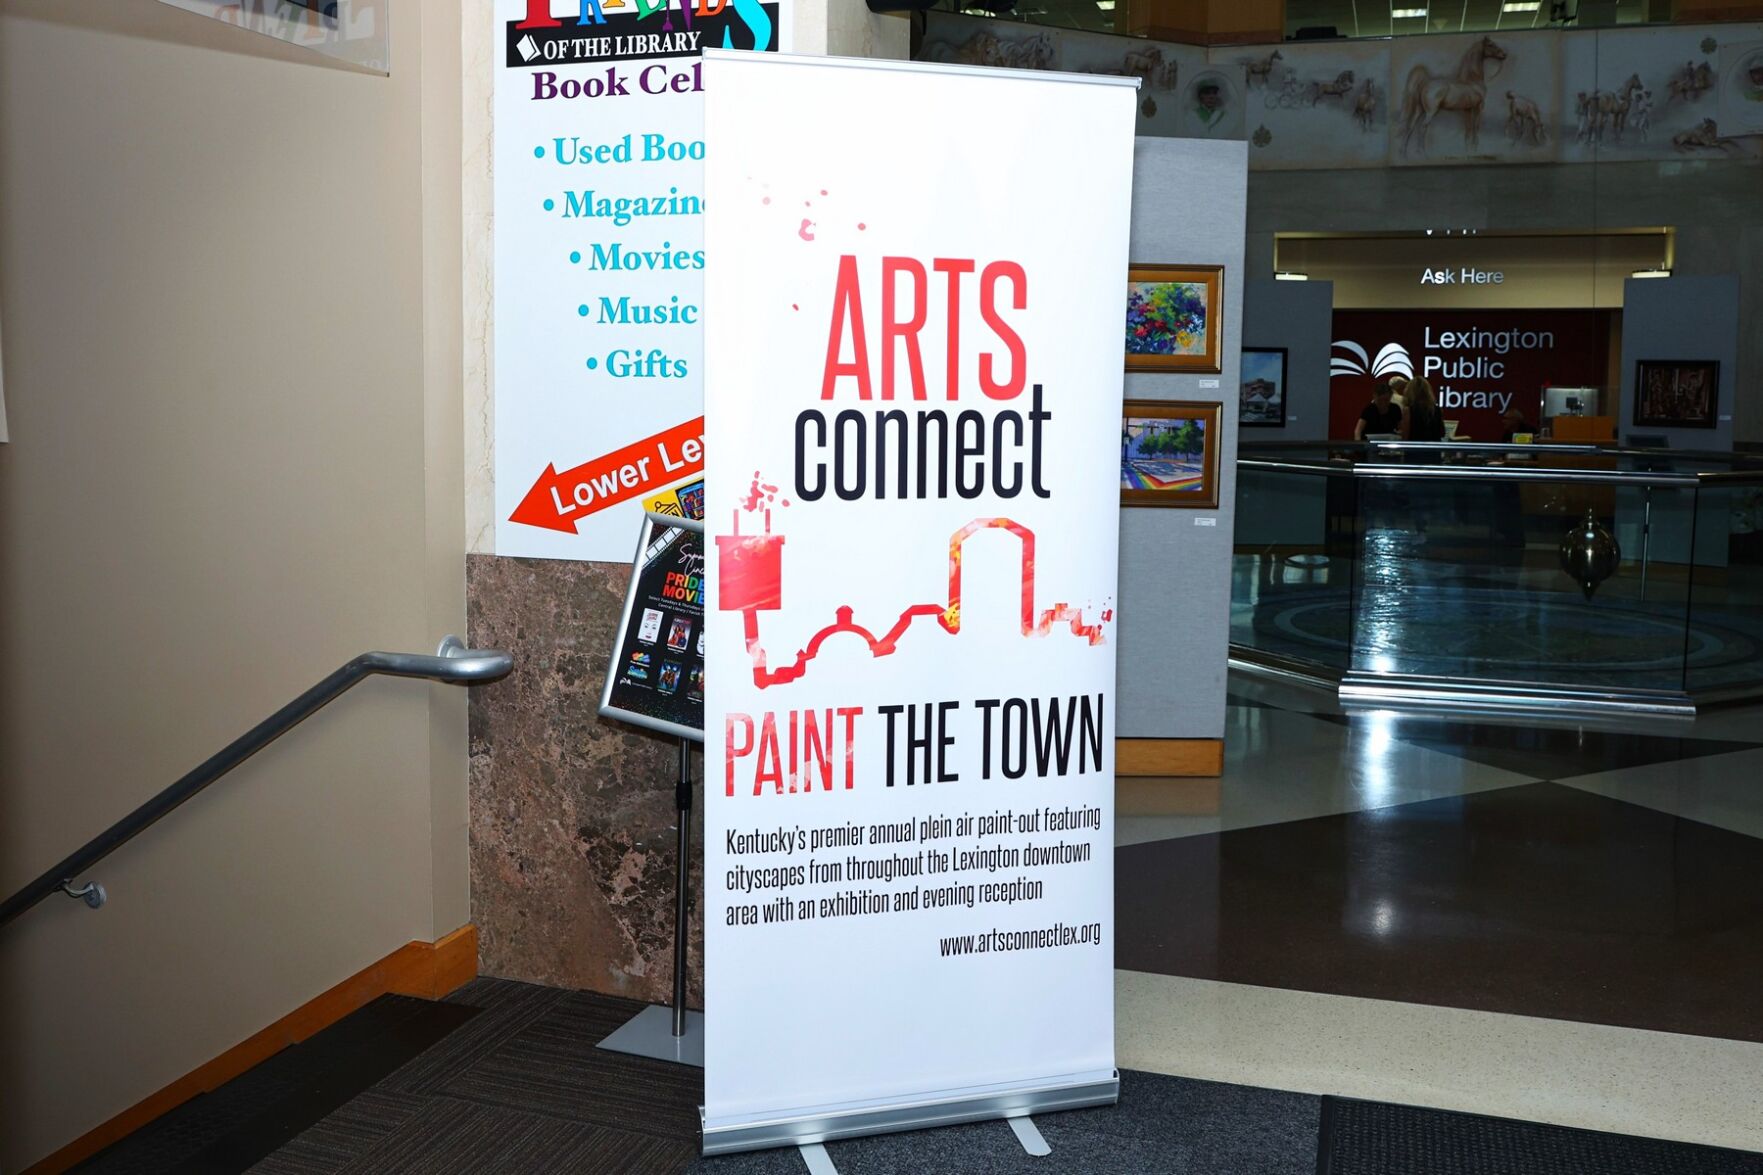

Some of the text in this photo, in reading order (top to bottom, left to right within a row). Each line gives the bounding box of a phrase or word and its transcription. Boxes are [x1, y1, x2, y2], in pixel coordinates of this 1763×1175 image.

[544, 31, 702, 60] OF THE LIBRARY
[531, 67, 630, 100] Book
[553, 134, 632, 165] Used
[588, 242, 705, 271] Movies
[1420, 268, 1504, 285] Ask Here
[597, 296, 698, 325] Music
[820, 254, 1027, 401] ARTS
[1424, 326, 1554, 354] Lexington
[606, 349, 688, 378] Gifts
[1424, 355, 1505, 379] Public
[1436, 386, 1513, 414] ibrary
[795, 384, 1052, 501] connect
[550, 456, 650, 516] Lower
[725, 693, 1103, 797] PAINT THE TOWN
[811, 820, 865, 853] premier
[870, 817, 916, 845] annual
[920, 813, 953, 845] plein
[956, 811, 975, 837] air
[979, 808, 1040, 839] paint-out
[1044, 804, 1101, 832] featuring
[726, 840, 1091, 894] cityscapes from throughout the Lexington downtown
[726, 876, 1042, 926] area with an exhibition and evening reception
[940, 922, 1101, 957] www.artsconnectlex.org
